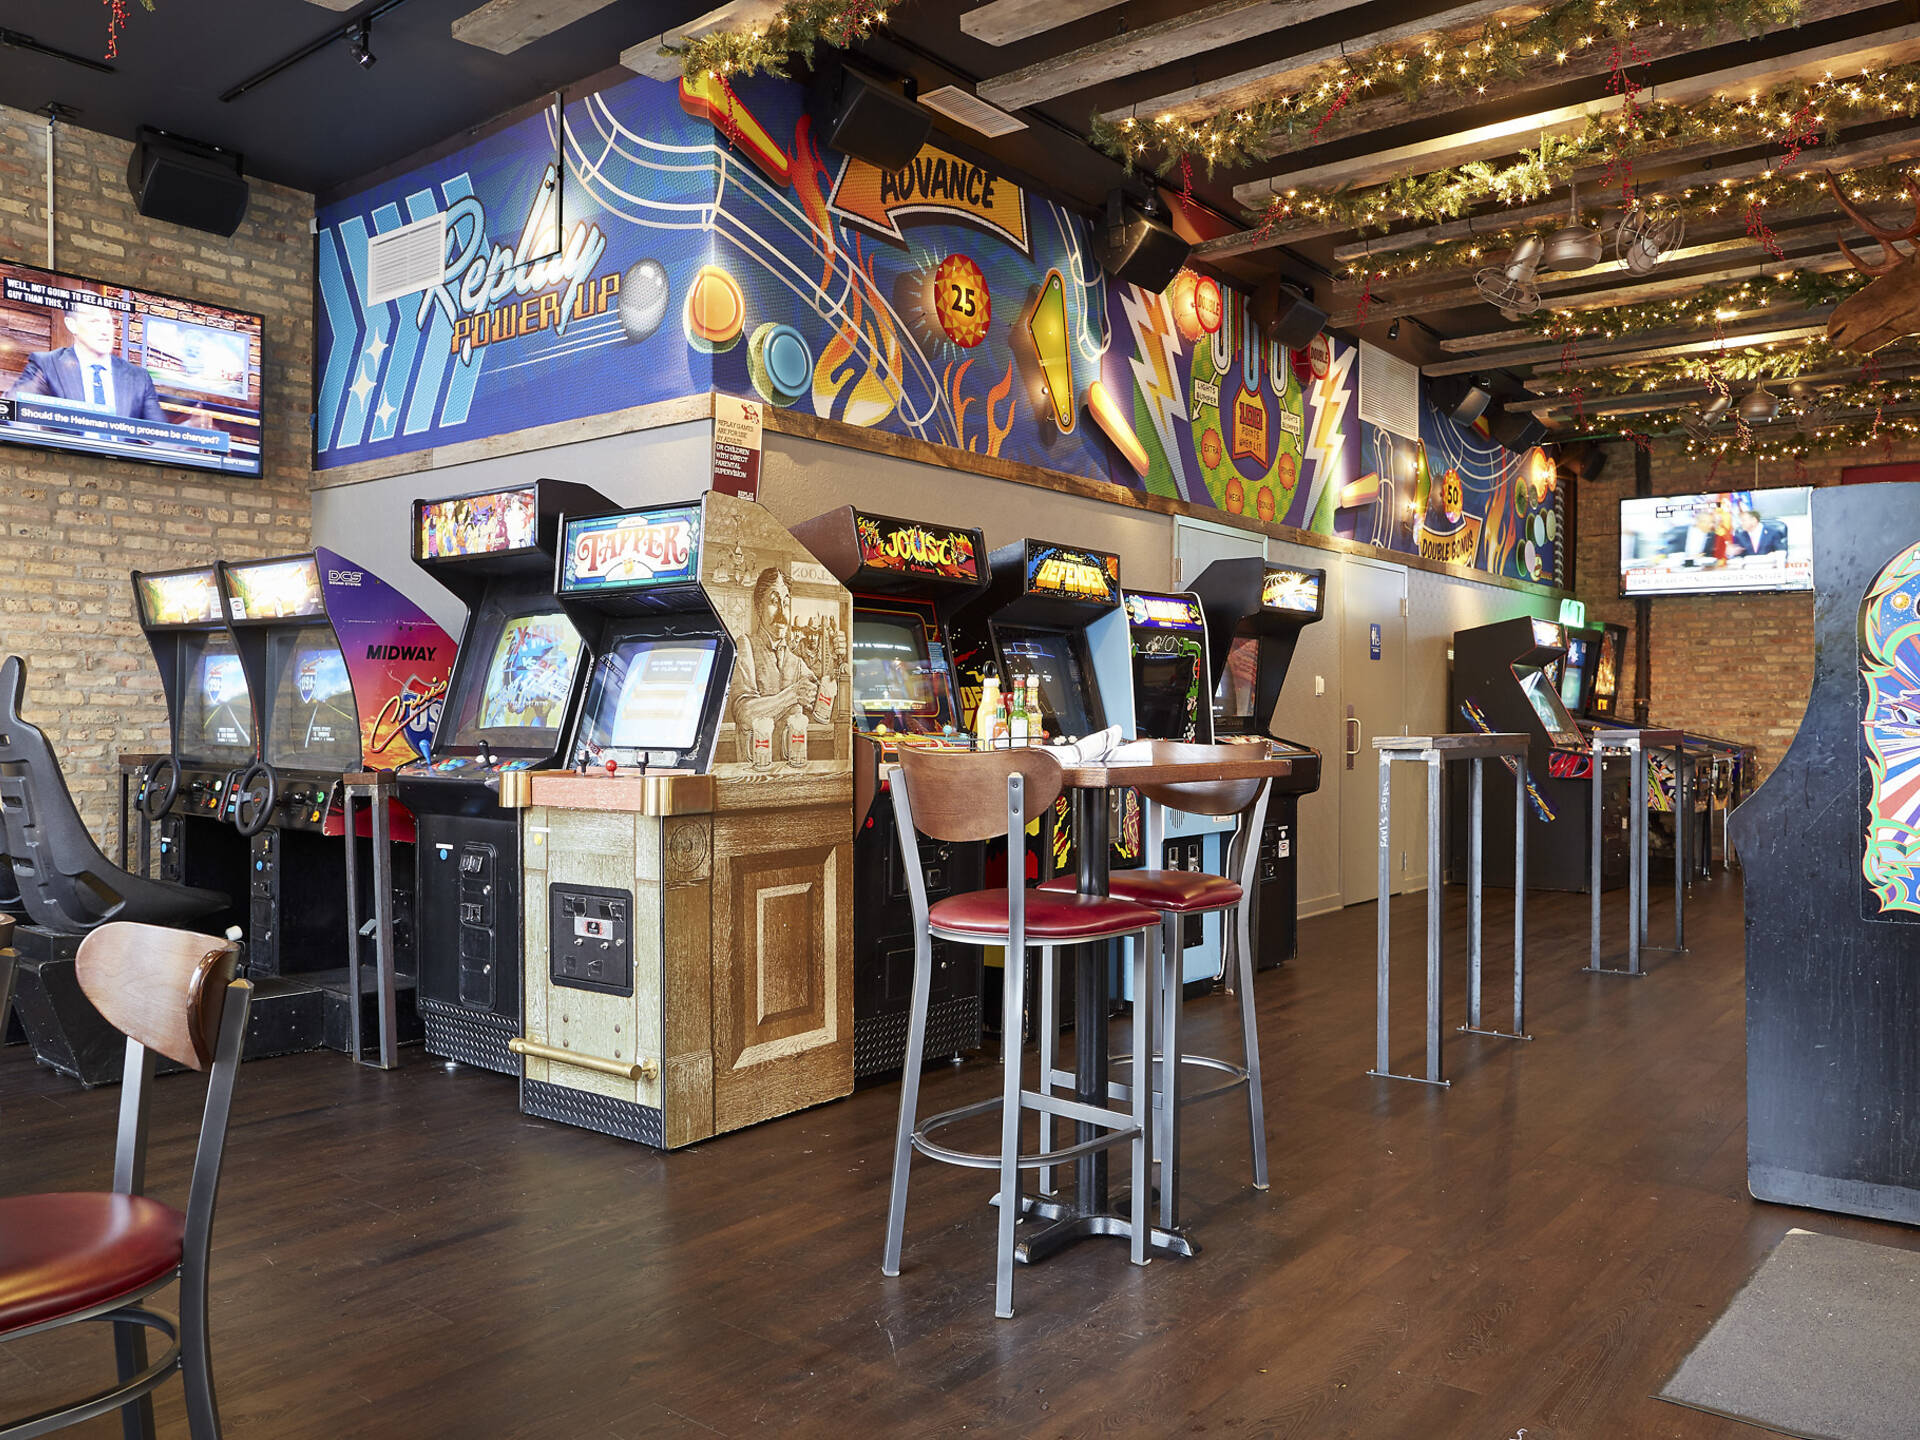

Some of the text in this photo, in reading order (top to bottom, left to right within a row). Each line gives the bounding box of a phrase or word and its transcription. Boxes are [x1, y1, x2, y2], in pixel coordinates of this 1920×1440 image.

[881, 157, 997, 208] ADVANCE
[7, 278, 30, 291] WELL,
[31, 283, 46, 294] NOT
[47, 286, 70, 299] GOING
[71, 291, 81, 301] TO
[82, 293, 96, 305] SEE
[104, 297, 131, 311] BETTER
[7, 290, 22, 300] GUY
[24, 293, 43, 305] THAN
[951, 284, 976, 317] 25
[451, 273, 621, 353] POWER UP
[21, 407, 52, 421] Should
[54, 413, 69, 424] the
[70, 415, 108, 429] Heisman
[109, 420, 135, 435] voting
[137, 425, 170, 440] process
[170, 430, 181, 439] be
[182, 431, 220, 445] changed?
[1240, 401, 1263, 430] 100
[1447, 485, 1458, 504] 50
[577, 525, 688, 571] TAPPER
[1422, 538, 1450, 562] DOUBLE
[328, 570, 361, 583] DCS
[1035, 558, 1110, 597] DEFENDER
[366, 645, 437, 661] MIDWAY
[409, 703, 443, 733] US
